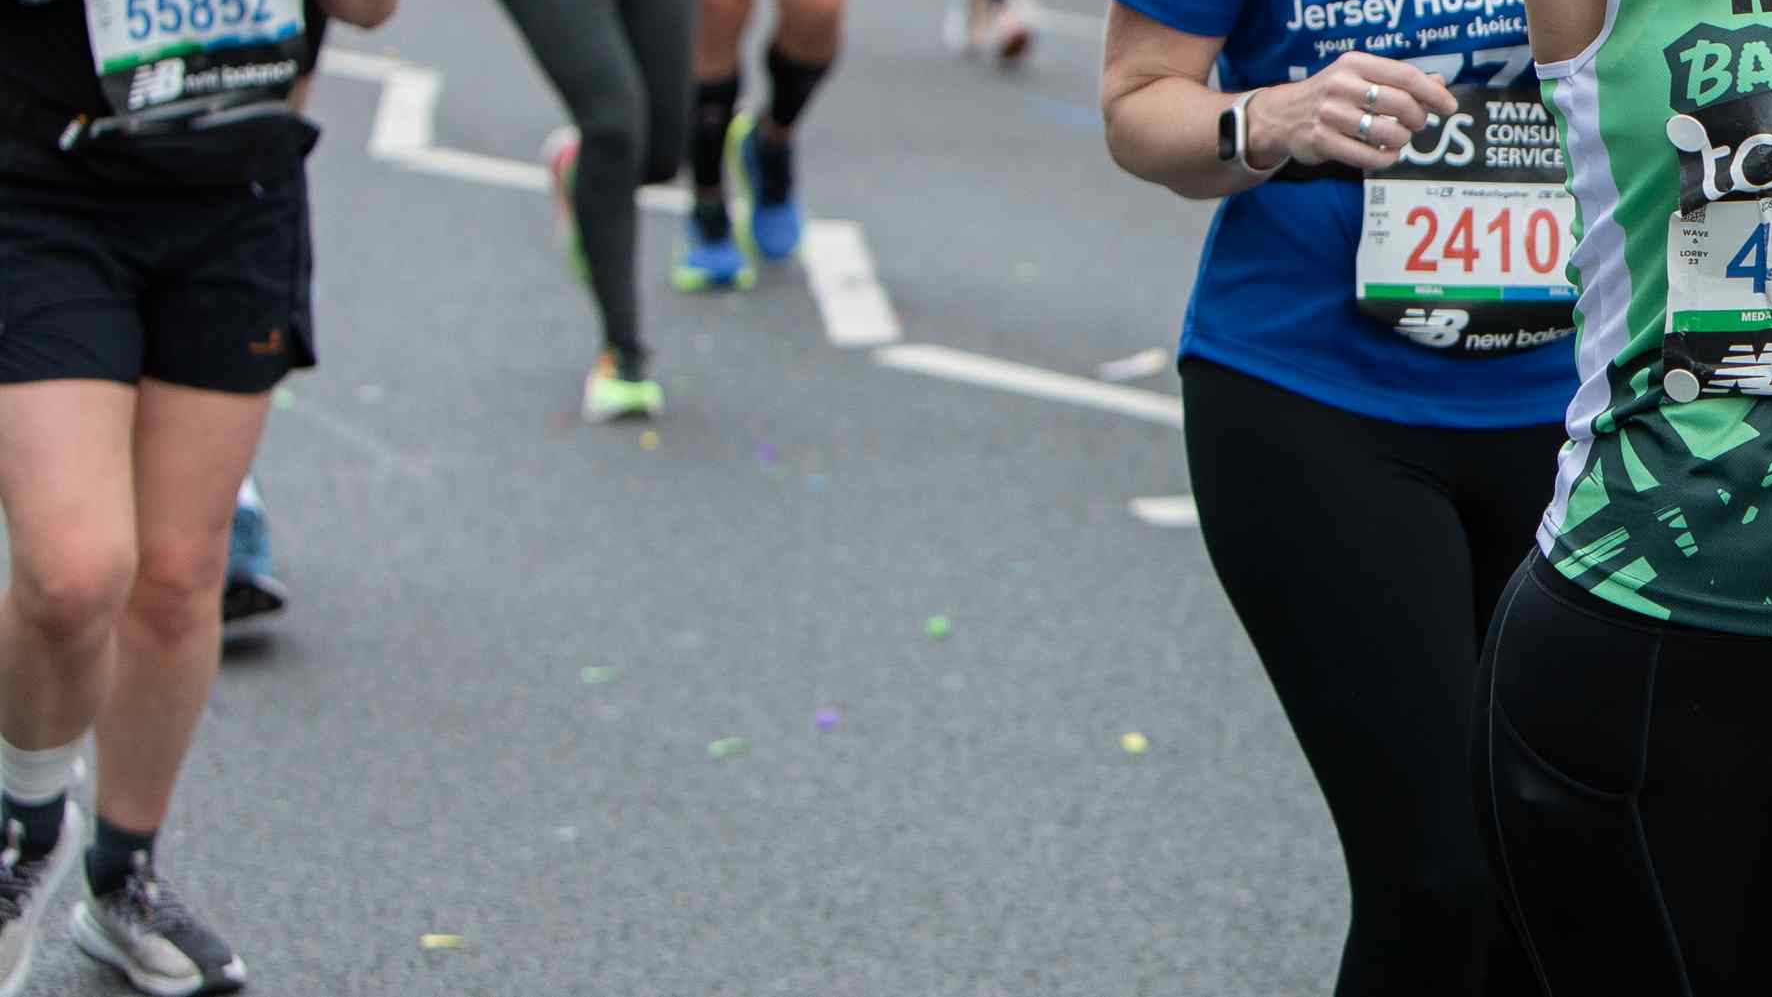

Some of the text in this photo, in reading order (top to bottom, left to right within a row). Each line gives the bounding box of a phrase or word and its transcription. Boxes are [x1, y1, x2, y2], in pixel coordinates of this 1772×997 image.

[1314, 37, 1356, 59] your
[1365, 32, 1411, 50] care,
[1416, 24, 1460, 50] your
[1484, 100, 1548, 121] TATA
[1400, 113, 1475, 166] cs
[1484, 147, 1566, 167] SERVICE
[1405, 205, 1561, 274] 2410
[1682, 228, 1709, 238] WAVE
[1465, 333, 1514, 350] new
